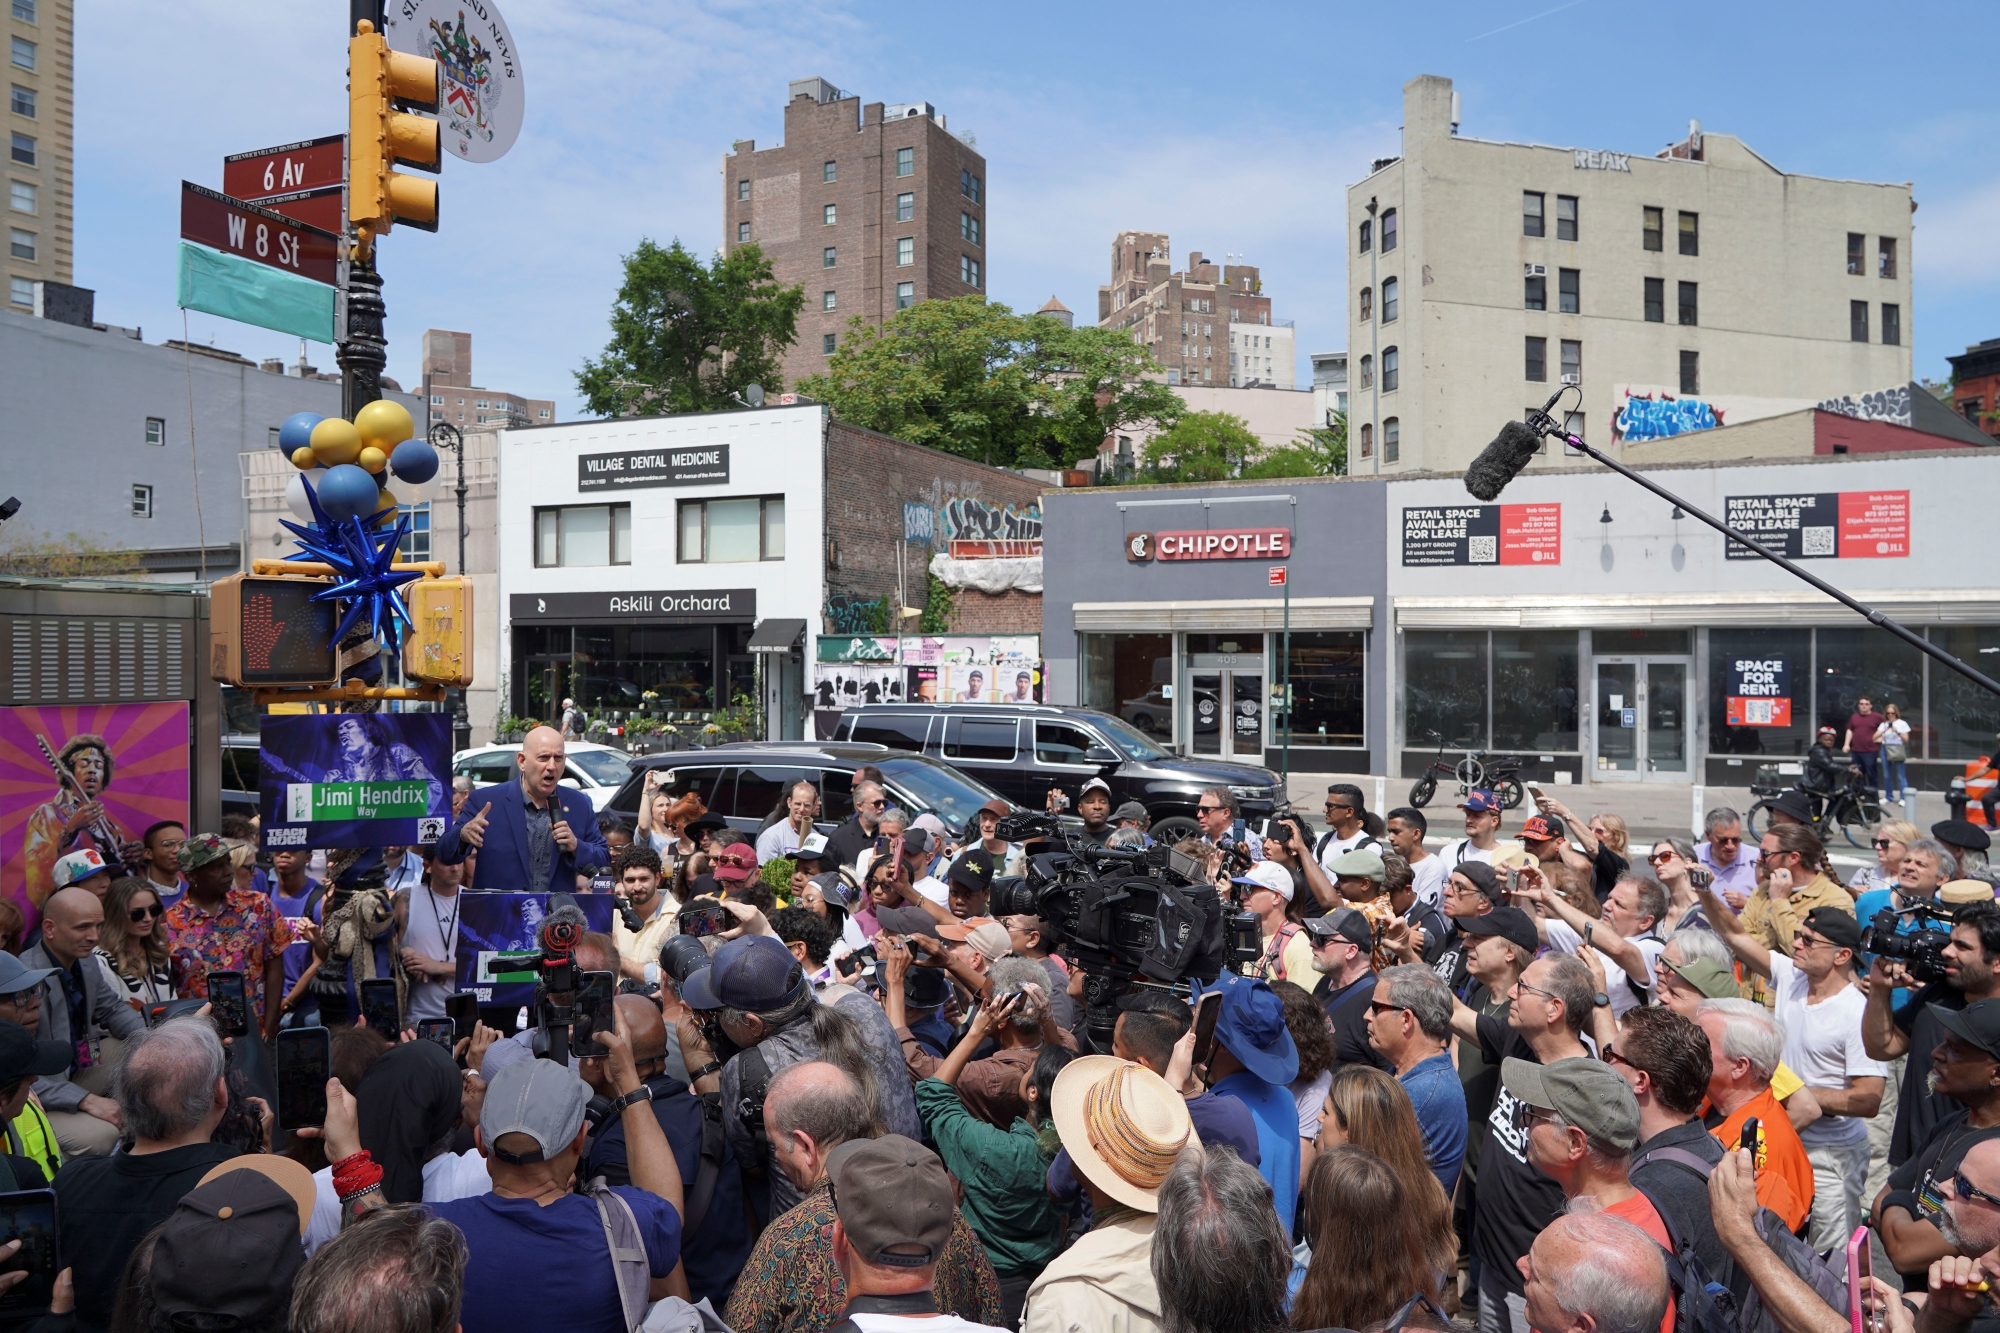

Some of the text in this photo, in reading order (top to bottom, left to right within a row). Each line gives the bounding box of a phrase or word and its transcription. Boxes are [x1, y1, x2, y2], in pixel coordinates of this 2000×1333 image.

[488, 22, 516, 78] NEVIS
[230, 140, 313, 162] GREENWICH VILLAGE HISTORIC DIST
[264, 158, 304, 191] 6 Av
[190, 184, 230, 204] GREENWICH
[232, 198, 260, 215] VILLAGE
[260, 208, 288, 224] HISTORIC
[288, 218, 302, 229] DIST
[228, 212, 300, 268] W 8 St
[586, 451, 720, 472] VILLAGE DENTAL MEDICINE
[683, 472, 698, 480] Avenue
[1728, 497, 1816, 510] RETAIL SPACE
[1406, 508, 1480, 520] RETAIL SPACE
[1728, 508, 1800, 520] AVAILABLE
[1406, 519, 1467, 530] AVAILABLE
[1728, 519, 1800, 530] FOR LEASE
[1406, 528, 1466, 540] FOR LEASE
[1160, 533, 1284, 554] CHIPOTLE
[1888, 543, 1905, 552] JLL
[1543, 552, 1556, 560] JLL
[610, 594, 731, 612] Askili Orchard
[1218, 656, 1237, 664] 405
[1735, 660, 1783, 672] SPACE
[1744, 672, 1774, 684] FOR
[1739, 684, 1780, 696] RENT.
[316, 784, 424, 807] Jimi Hendrix
[357, 806, 377, 818] Way
[420, 819, 444, 830] EXPERIENCE
[267, 828, 307, 837] TEACH
[267, 836, 307, 846] ROCK
